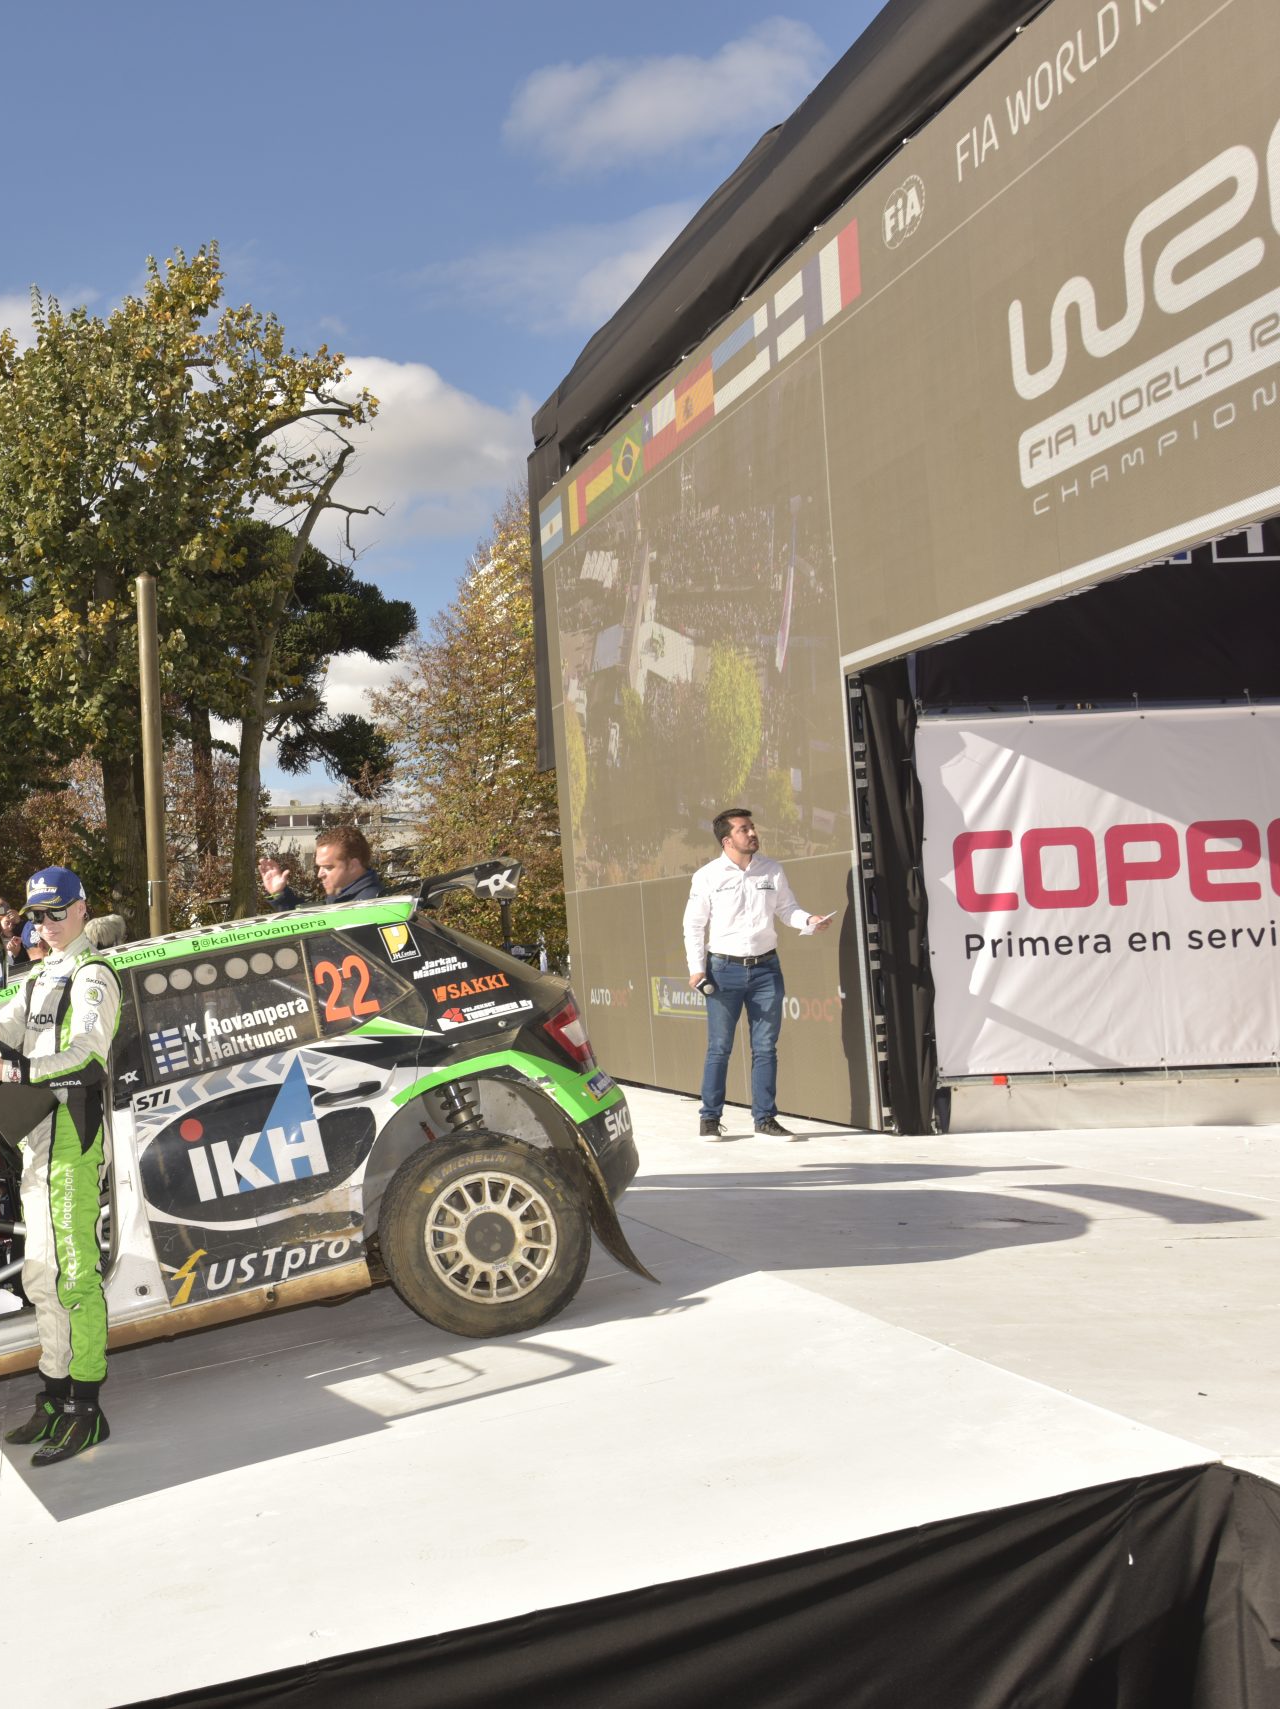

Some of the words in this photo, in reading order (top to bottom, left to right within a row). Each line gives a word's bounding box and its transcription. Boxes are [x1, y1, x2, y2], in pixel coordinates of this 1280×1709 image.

[956, 113, 1000, 183] FIA
[1005, 0, 1120, 136] WORLD
[1007, 116, 1280, 401] WR
[1028, 424, 1077, 469] FIA
[1088, 338, 1233, 437] WORLD
[952, 817, 1280, 913] COPE
[112, 946, 168, 967] Racing
[964, 931, 1112, 960] Primera
[1128, 930, 1171, 953] en
[412, 961, 468, 980] Maansiirto
[421, 956, 458, 971] Jarkan
[314, 955, 381, 1023] 22
[446, 973, 511, 1000] SAKKI
[134, 1087, 171, 1113] STI
